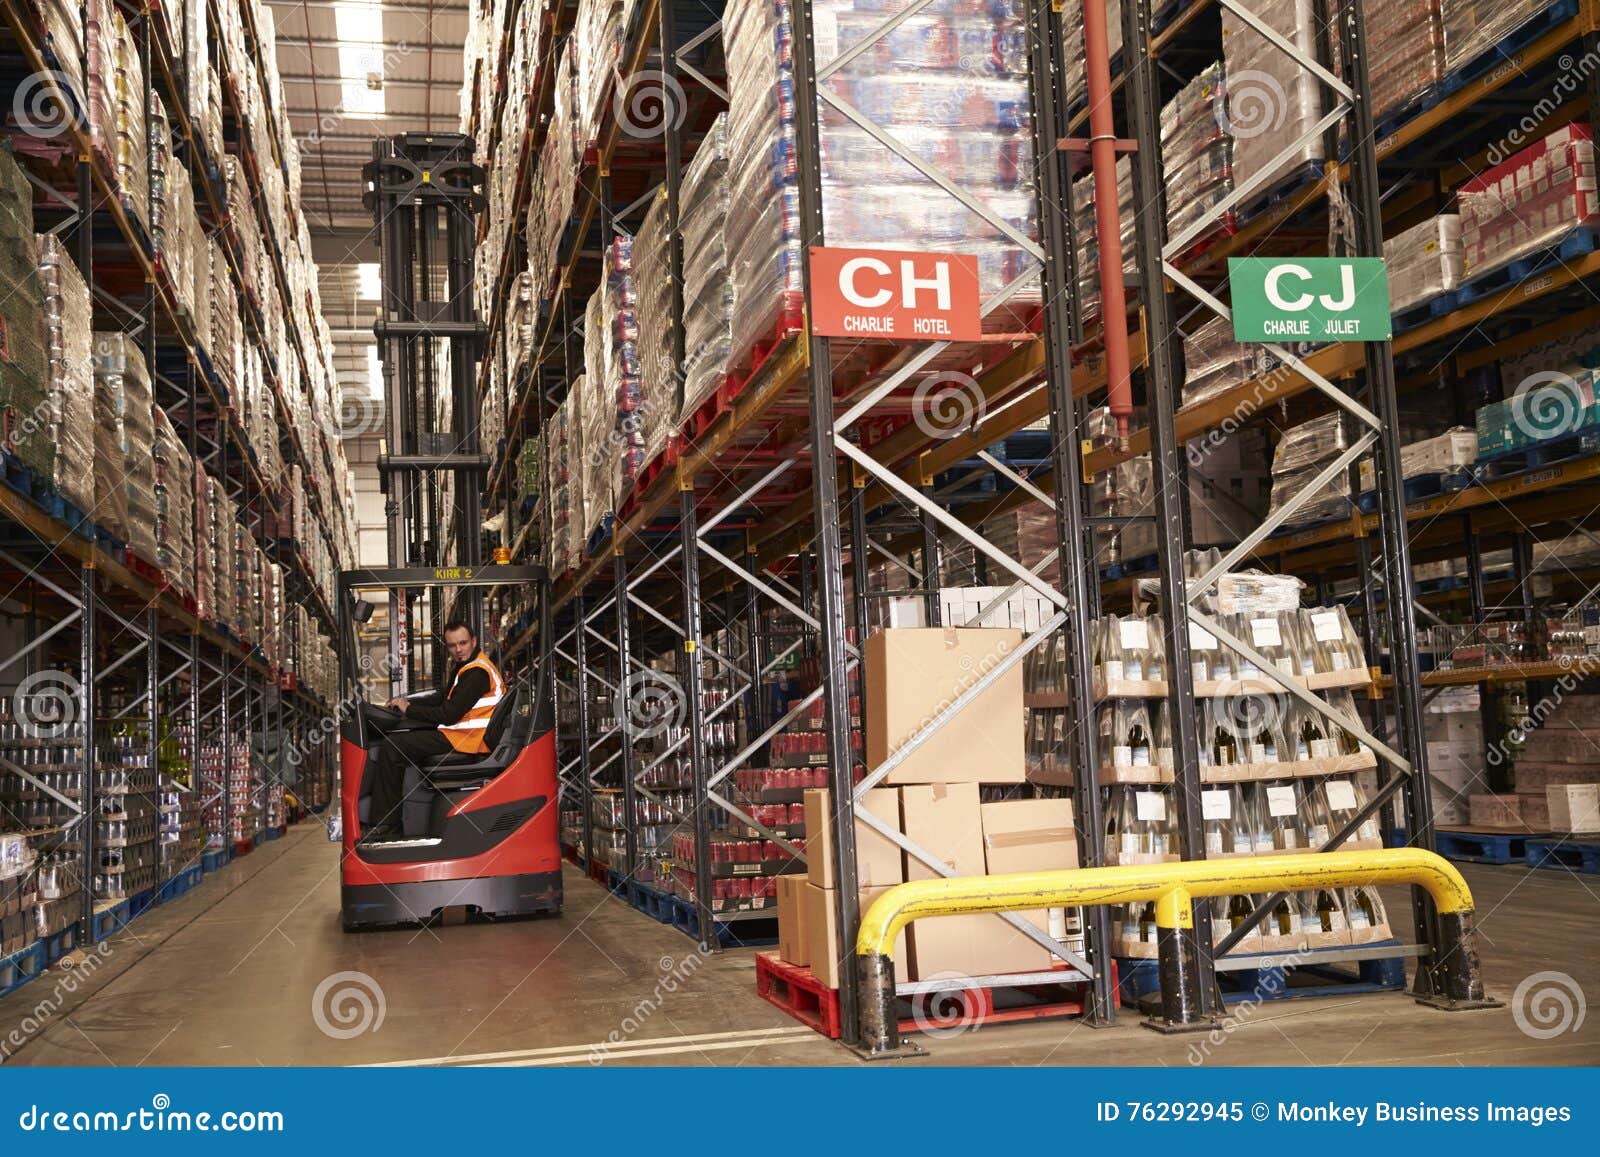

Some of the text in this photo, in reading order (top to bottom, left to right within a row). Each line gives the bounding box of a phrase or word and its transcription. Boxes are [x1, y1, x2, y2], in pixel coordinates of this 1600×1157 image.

[838, 257, 952, 310] CH
[1264, 263, 1356, 312] CJ
[843, 315, 951, 334] CHARLIE HOTEL
[1263, 320, 1360, 335] CHARLIE JULIET
[435, 568, 472, 579] KIRK 2
